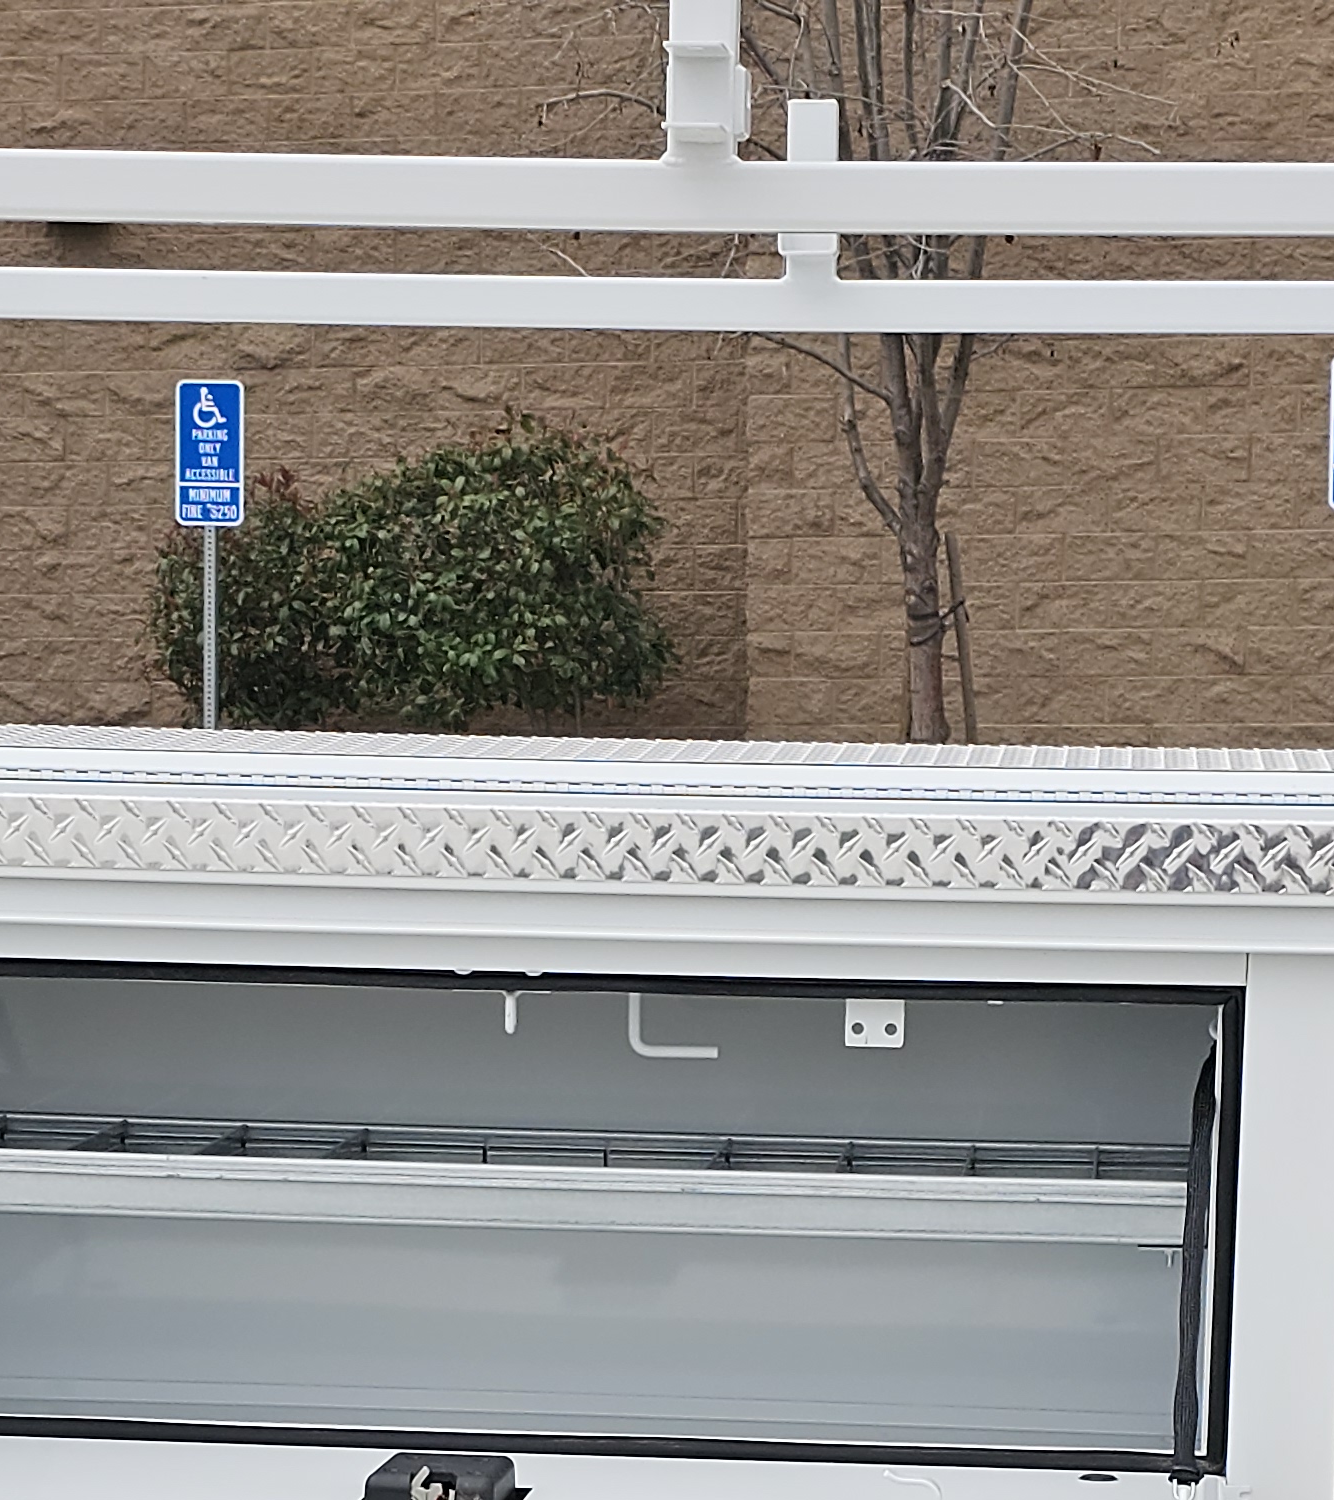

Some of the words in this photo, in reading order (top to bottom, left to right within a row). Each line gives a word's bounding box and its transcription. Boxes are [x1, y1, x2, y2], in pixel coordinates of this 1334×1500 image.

[192, 429, 228, 441] PARKING
[199, 442, 221, 454] ONLY
[201, 456, 218, 467] VAN
[185, 468, 235, 481] ACCESSIBLE
[189, 488, 231, 502] MINIMUM
[182, 504, 203, 519] FINE
